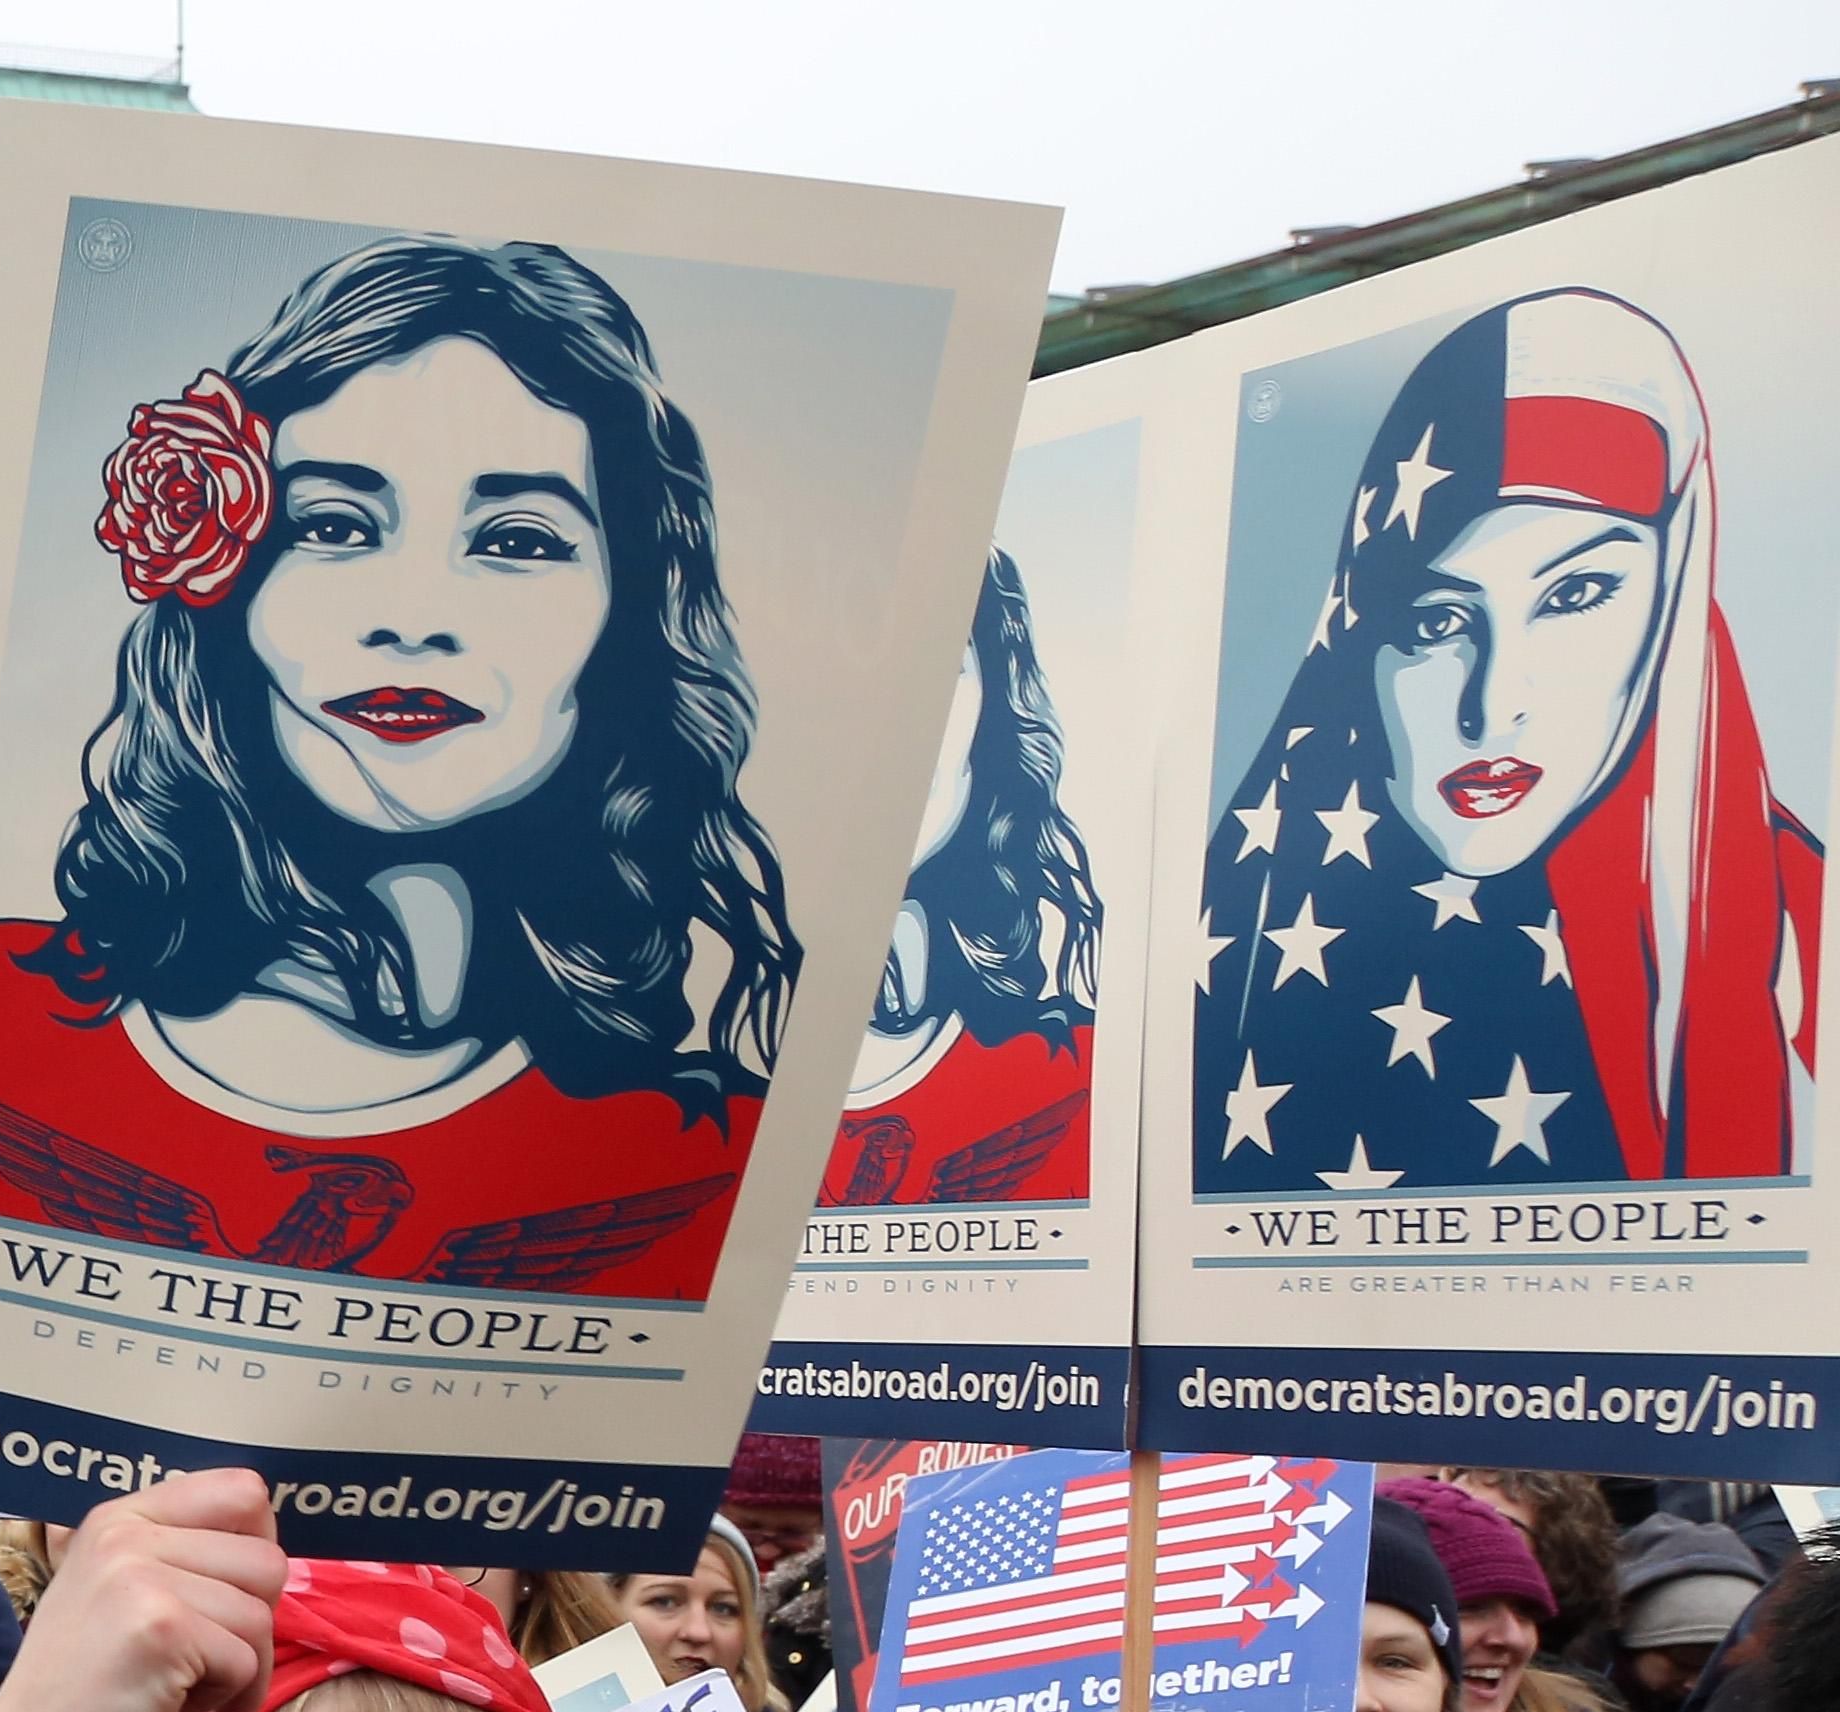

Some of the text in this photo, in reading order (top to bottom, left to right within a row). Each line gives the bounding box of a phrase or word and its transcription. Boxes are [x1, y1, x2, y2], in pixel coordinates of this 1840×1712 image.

[801, 1218, 1041, 1256] THE PEOPLE
[1249, 1201, 1731, 1249] WE THE PEOPLE
[1, 1239, 614, 1358] WE THE PEOPLE
[785, 1278, 1019, 1294] FEND DIGNITY
[1277, 1274, 1696, 1294] ARE GREATER THAN FEAR
[32, 1319, 561, 1403] DEFEND DIGNITY
[756, 1360, 1100, 1412] cratsabroad.org/join
[1177, 1366, 1817, 1437] democratsabroad.org/join
[844, 1472, 908, 1541] OUR
[1081, 1652, 1295, 1708] toether!
